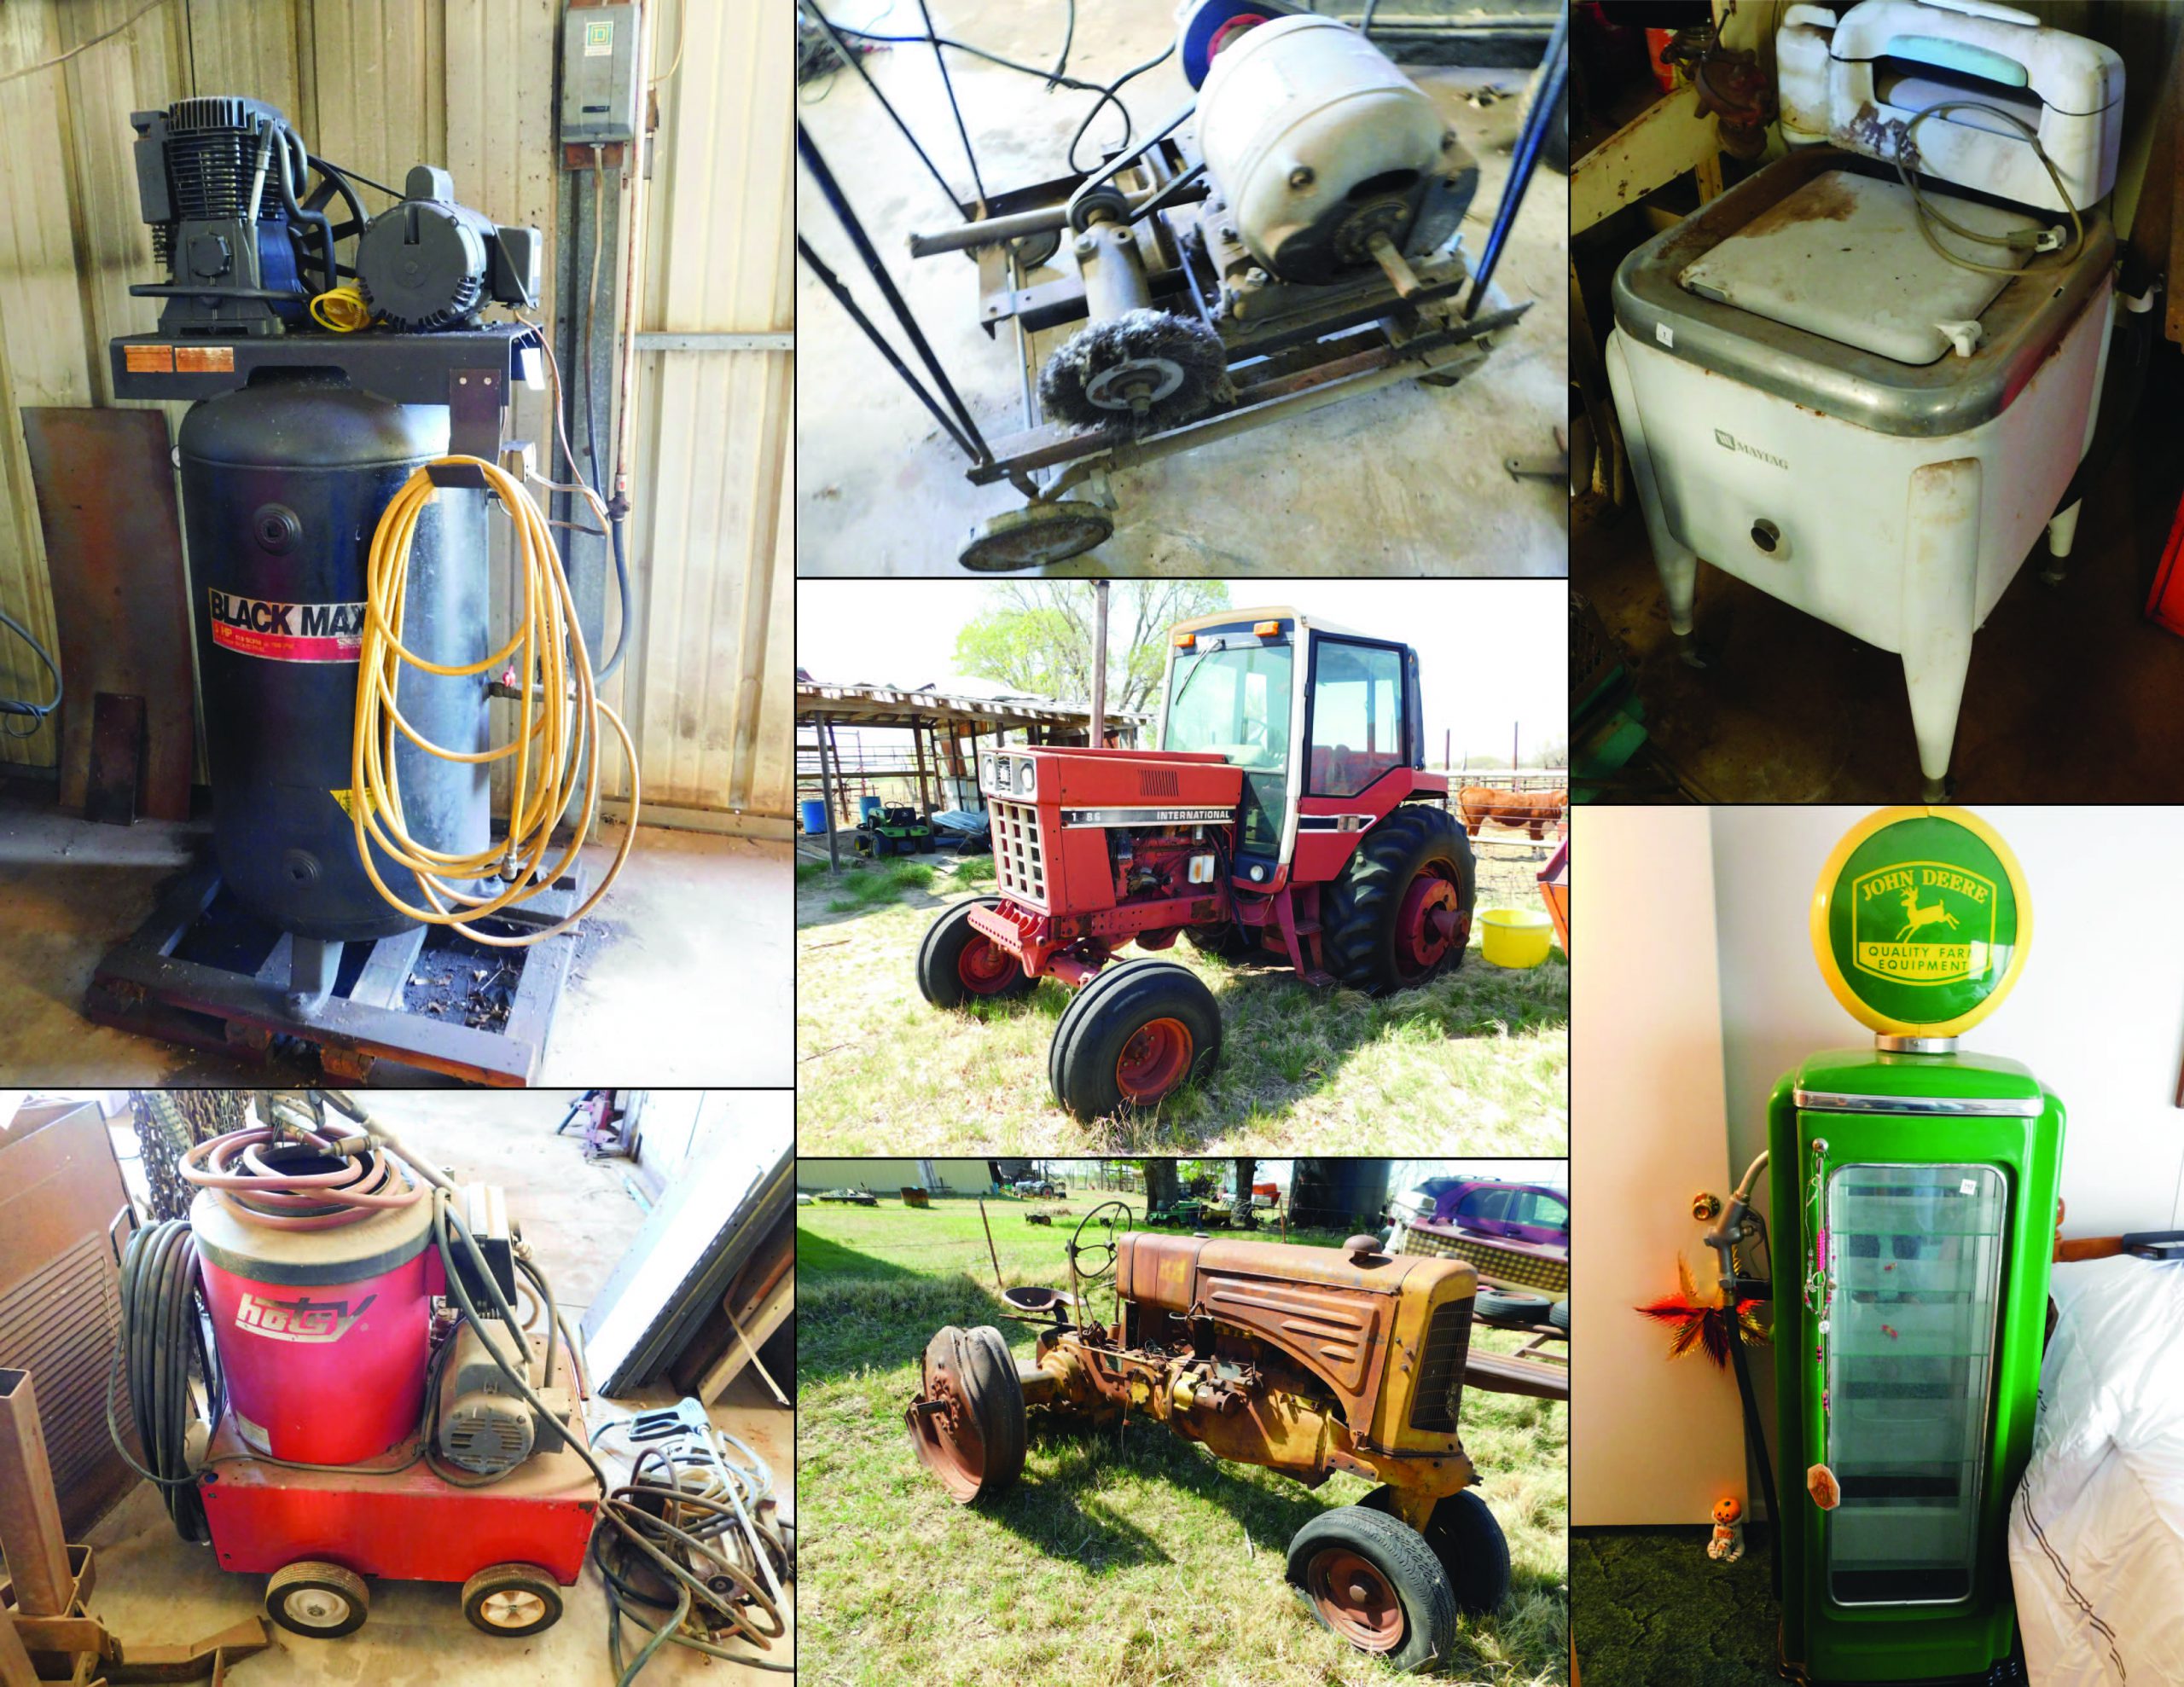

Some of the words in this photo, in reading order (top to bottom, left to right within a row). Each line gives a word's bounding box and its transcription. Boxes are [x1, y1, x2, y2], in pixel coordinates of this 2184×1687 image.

[1736, 441, 1789, 470] MAYTAG
[212, 590, 293, 636] BLACK
[1156, 810, 1230, 820] INTERNATIONAL
[1862, 870, 1914, 901] JOHN
[1921, 869, 1989, 904] DEERE
[1868, 947, 1929, 958] QUALITY
[1879, 959, 1967, 971] EQUIPMENT
